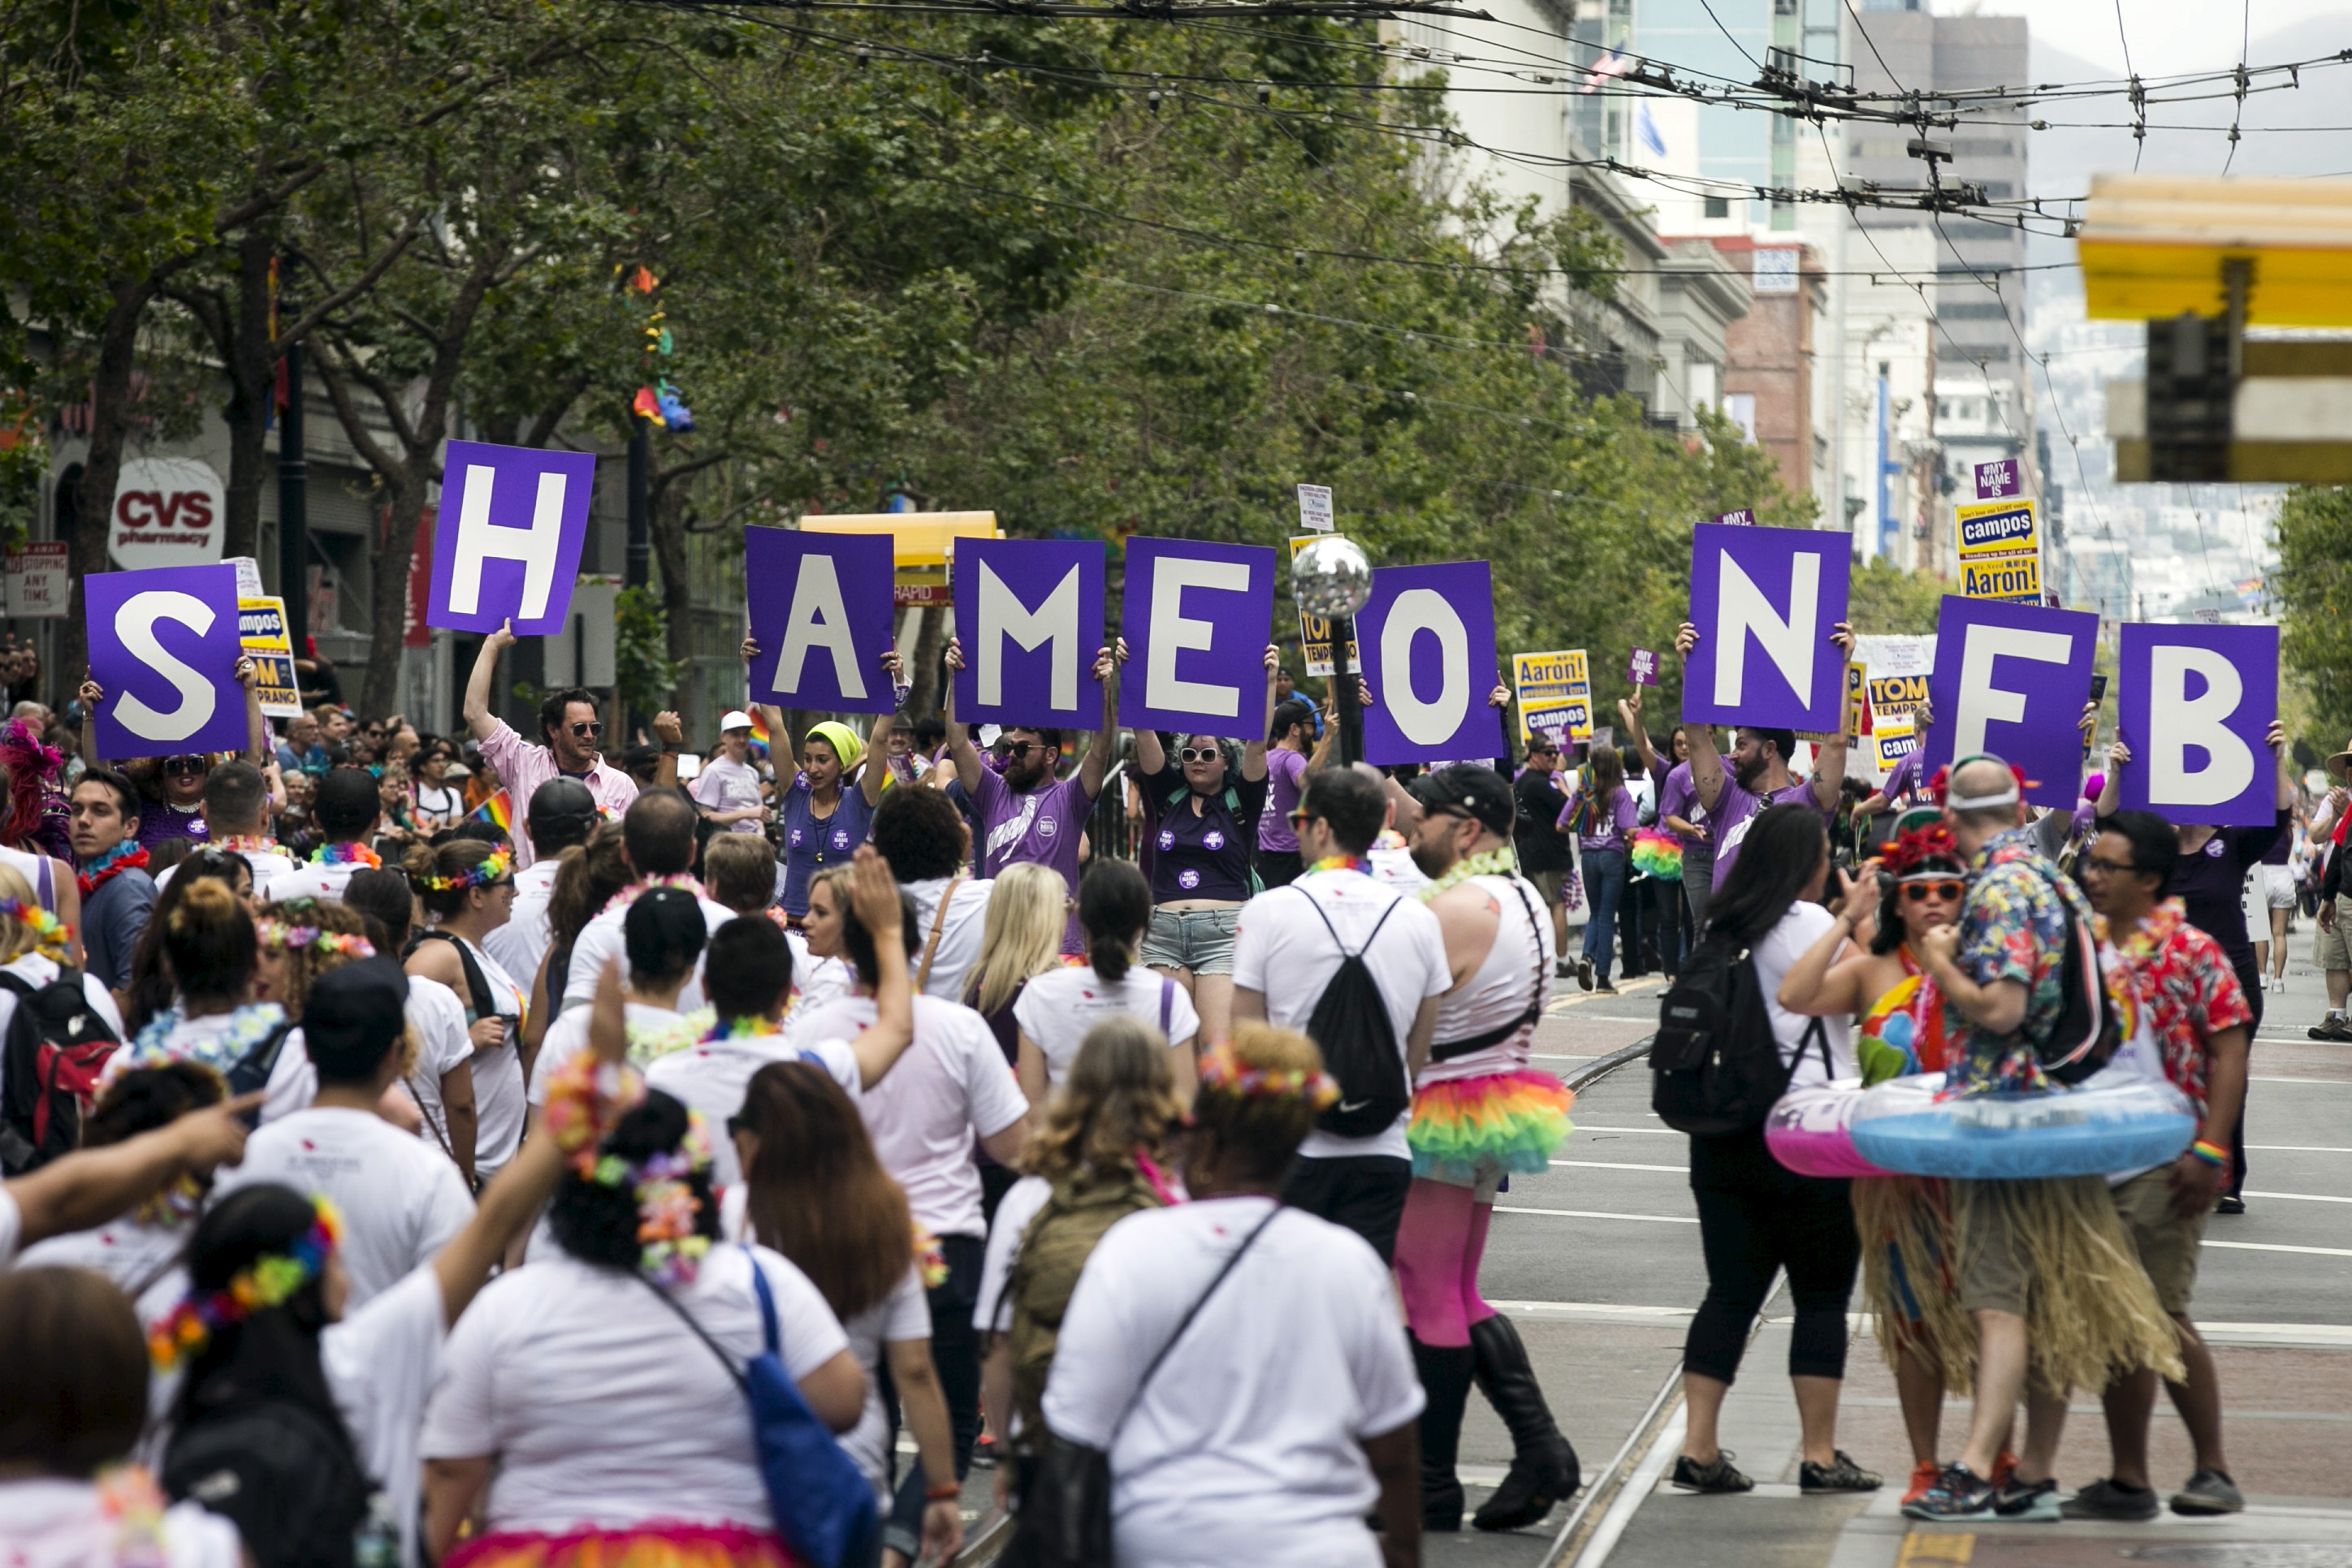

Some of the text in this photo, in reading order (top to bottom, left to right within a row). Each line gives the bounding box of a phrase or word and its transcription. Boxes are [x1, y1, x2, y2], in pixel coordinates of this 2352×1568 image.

[1980, 472, 2011, 487] NAME
[1983, 462, 2005, 476] #MY
[1991, 486, 2002, 497] IS
[117, 490, 213, 529] CVS
[1723, 510, 1746, 525] #MY
[1965, 514, 2031, 539] campos
[117, 529, 210, 548] pharmacy
[449, 464, 567, 620] H
[24, 558, 64, 570] STOPPING
[24, 574, 47, 586] ANY
[1966, 561, 2037, 595] Aaron!
[24, 589, 49, 601] TIME
[894, 585, 932, 600] RAPID
[239, 614, 281, 634] mpos
[772, 554, 867, 698] A
[979, 558, 1079, 711] M
[1714, 547, 1820, 711] N
[1146, 556, 1250, 717] E
[113, 591, 216, 741] S
[1381, 589, 1469, 745] O
[1522, 656, 1583, 682] Aaron!
[1632, 659, 1654, 675] NAME
[257, 690, 296, 704] PRANO
[1871, 676, 1930, 702] TOM
[1952, 623, 2073, 765] F
[1528, 707, 1586, 728] campos
[1875, 703, 1917, 716] TEMPR
[2149, 646, 2255, 806] B
[1883, 737, 1917, 758] cam
